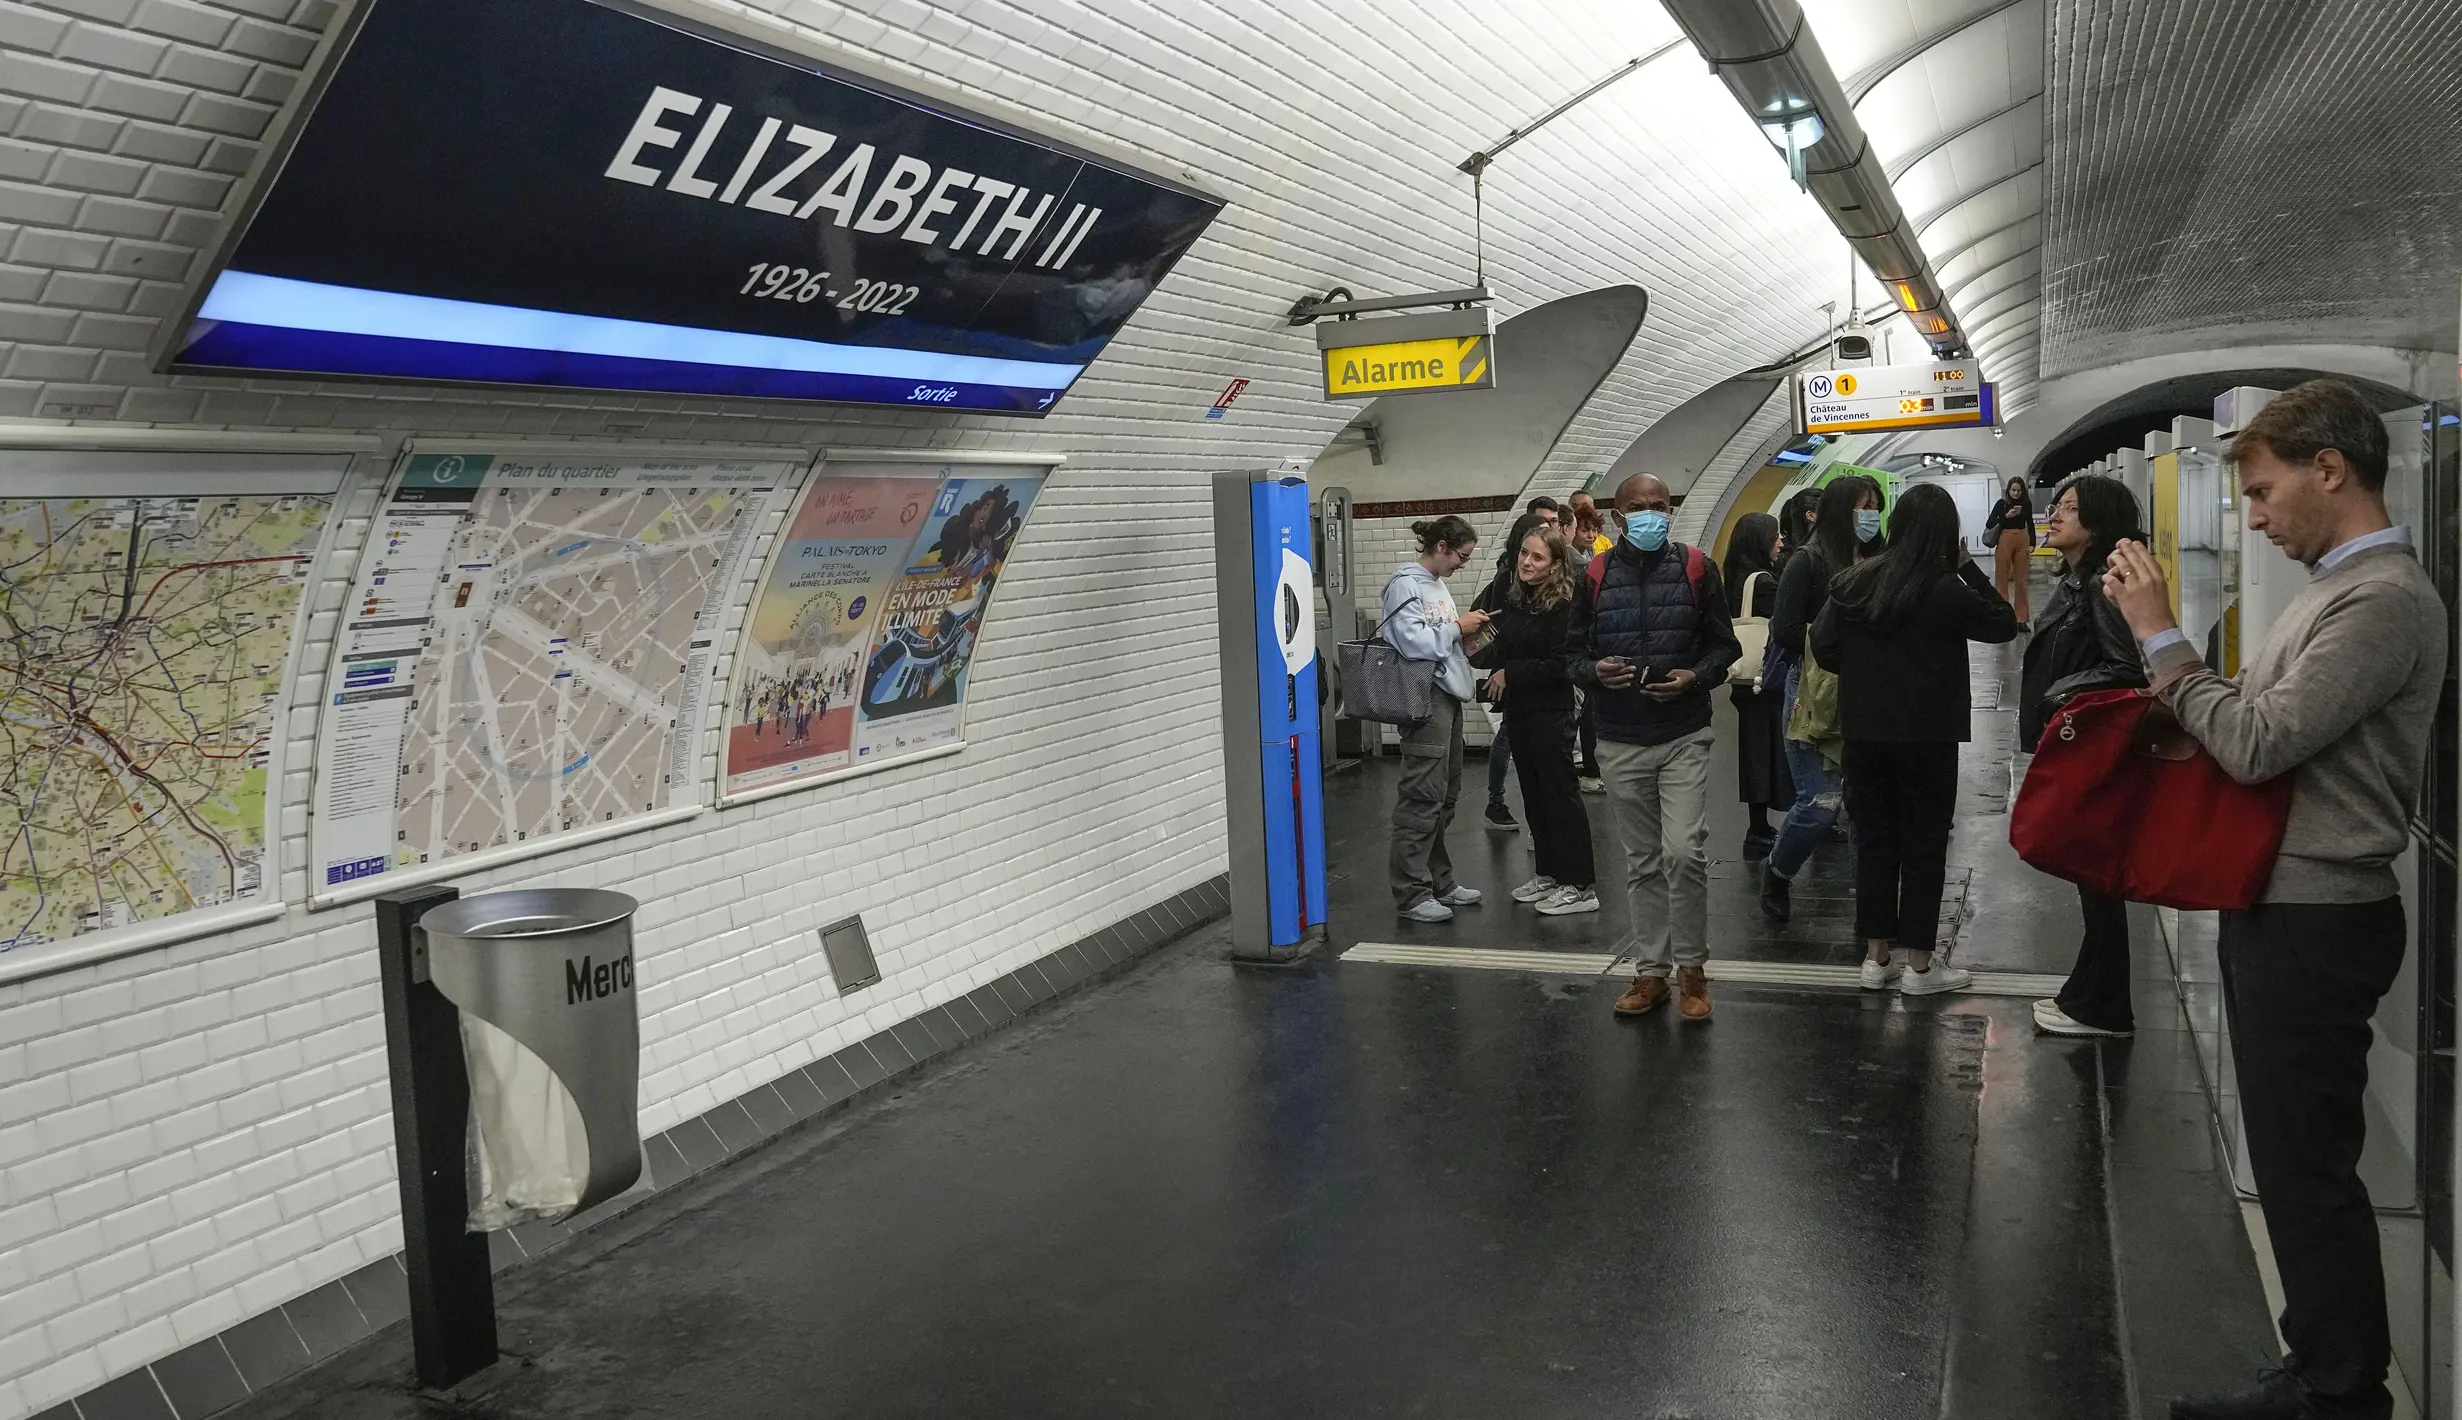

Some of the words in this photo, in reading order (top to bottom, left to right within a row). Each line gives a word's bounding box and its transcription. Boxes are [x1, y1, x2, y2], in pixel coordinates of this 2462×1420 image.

[604, 85, 1055, 262] ELIZABETH
[1035, 203, 1102, 271] II
[740, 262, 831, 303] 1926
[836, 278, 920, 316] 2022
[1341, 357, 1444, 386] Alarme
[907, 385, 958, 402] Sortie
[1810, 404, 1847, 414] Château
[1811, 415, 1822, 423] de
[1824, 412, 1870, 422] Vincennes
[497, 462, 533, 478] Plan
[537, 463, 556, 478] du
[559, 463, 622, 482] quartier
[801, 546, 846, 558] PALAIS
[848, 546, 887, 556] TOKYO
[789, 579, 831, 588] MARINELLA
[833, 577, 872, 586] SENATORE
[827, 570, 861, 578] BLANCHE
[825, 590, 838, 600] DES
[888, 592, 911, 610] EN
[911, 588, 958, 609] MODE
[881, 604, 945, 632] ILLIMITÉ
